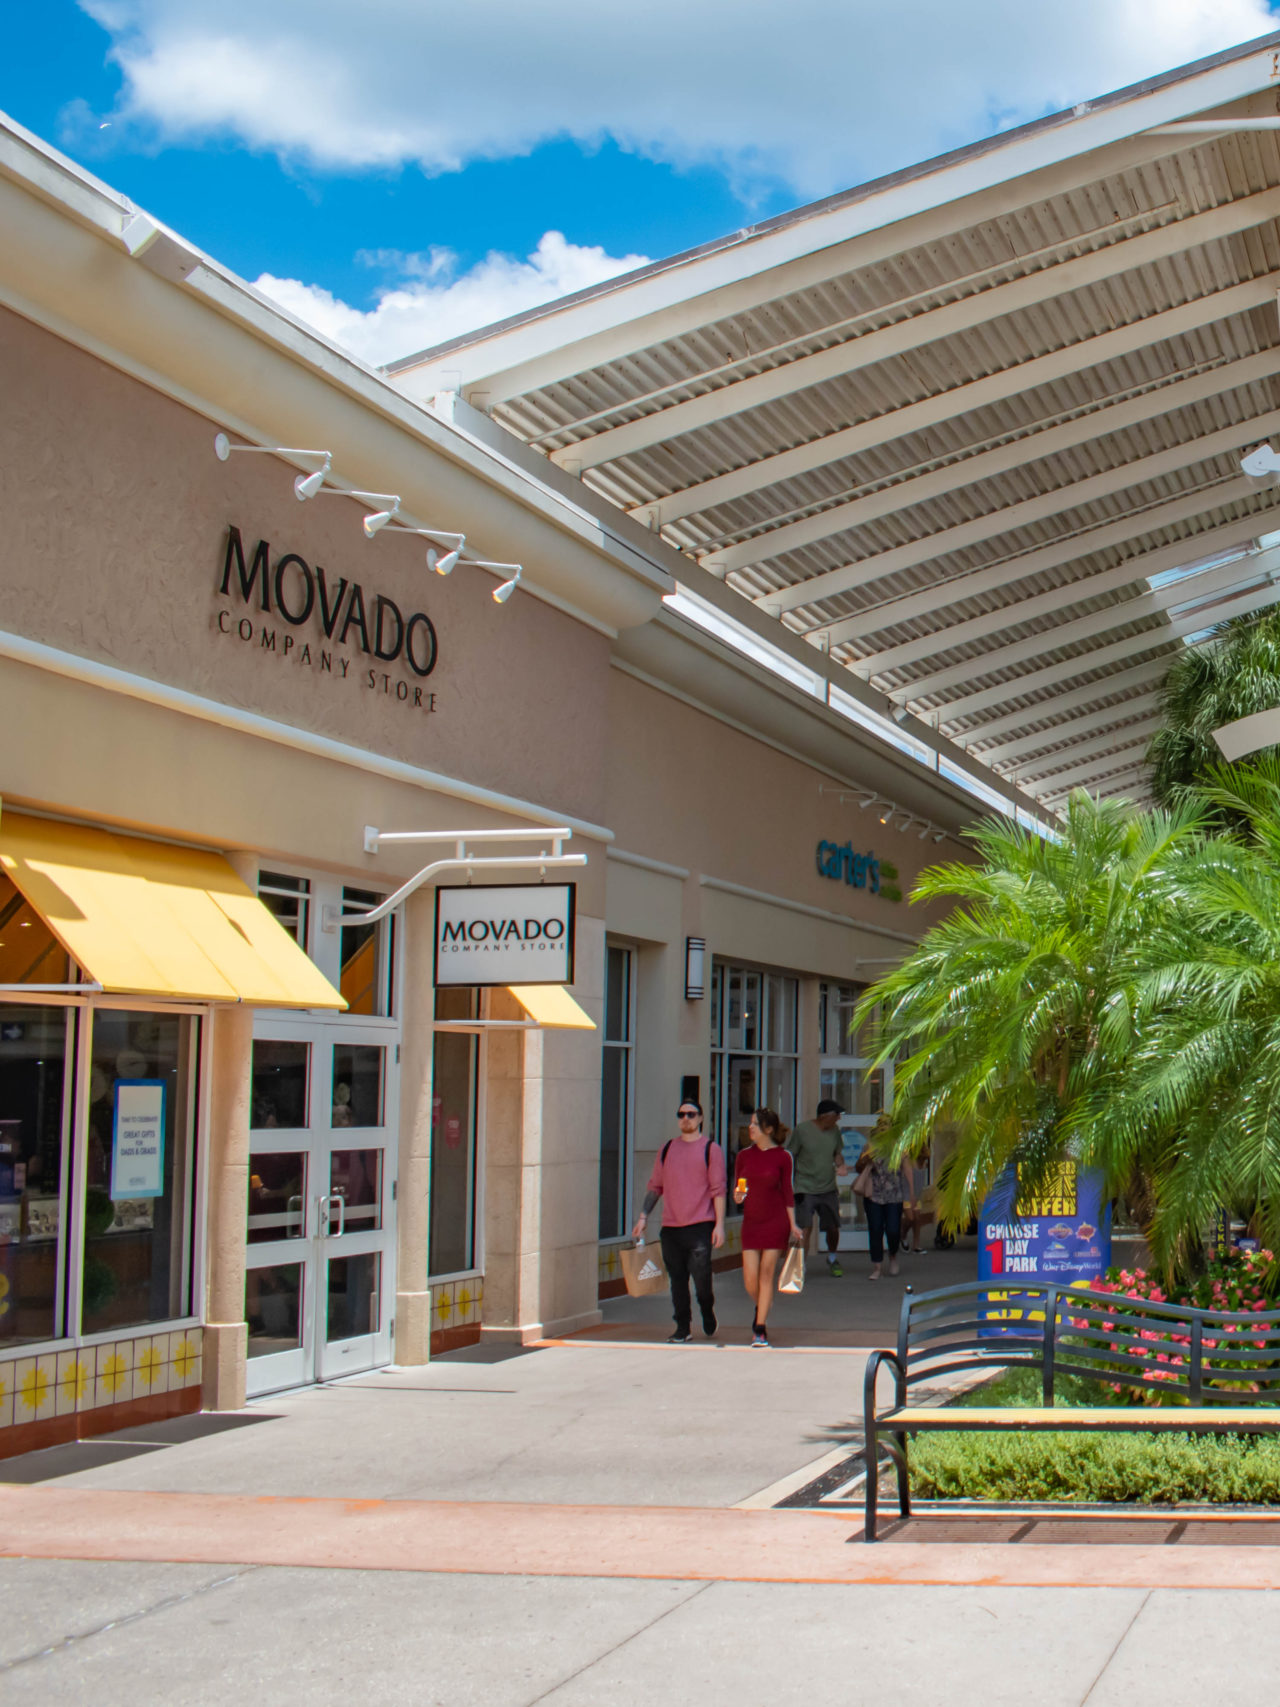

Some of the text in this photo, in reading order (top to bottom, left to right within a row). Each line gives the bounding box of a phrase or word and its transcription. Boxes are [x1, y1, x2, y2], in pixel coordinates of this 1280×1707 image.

[220, 524, 438, 677] MOVADO
[218, 610, 437, 712] COMPANY STORE
[442, 918, 565, 941] MOVADO
[441, 942, 564, 952] COMPANY STORE
[985, 1239, 1003, 1274] 1
[1006, 1240, 1029, 1255] DAY
[1006, 1257, 1038, 1272] PARK
